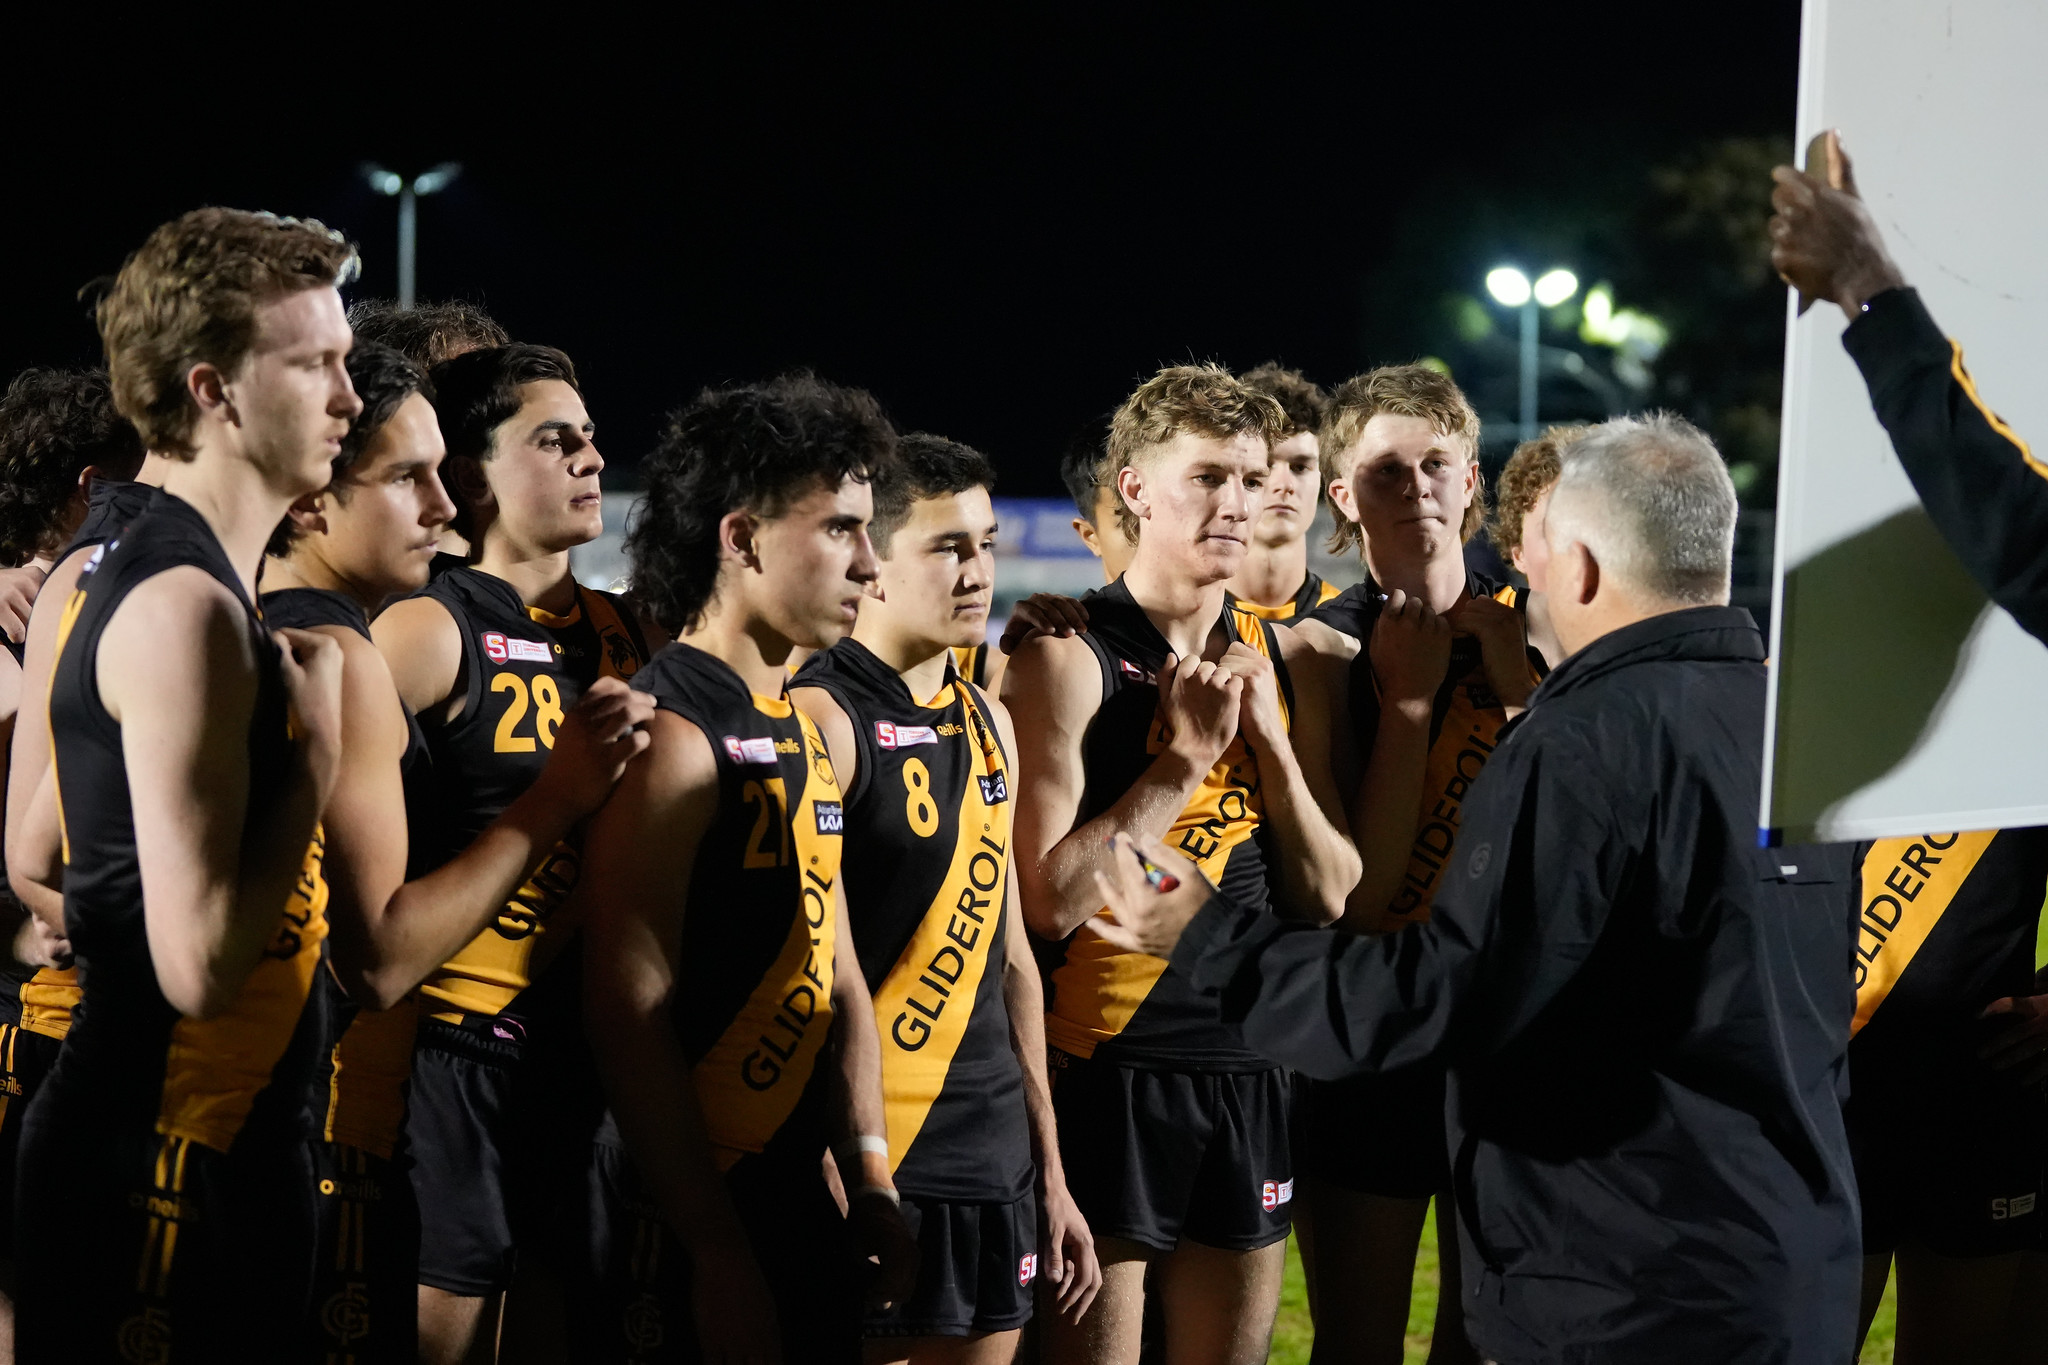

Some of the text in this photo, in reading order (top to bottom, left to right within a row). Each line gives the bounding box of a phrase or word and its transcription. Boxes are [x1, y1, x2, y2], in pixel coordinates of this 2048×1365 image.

[491, 672, 566, 753] 28
[902, 757, 939, 838] 8
[742, 868, 833, 1091] GLIDEOL
[892, 835, 1006, 1052] GLIDEROL
